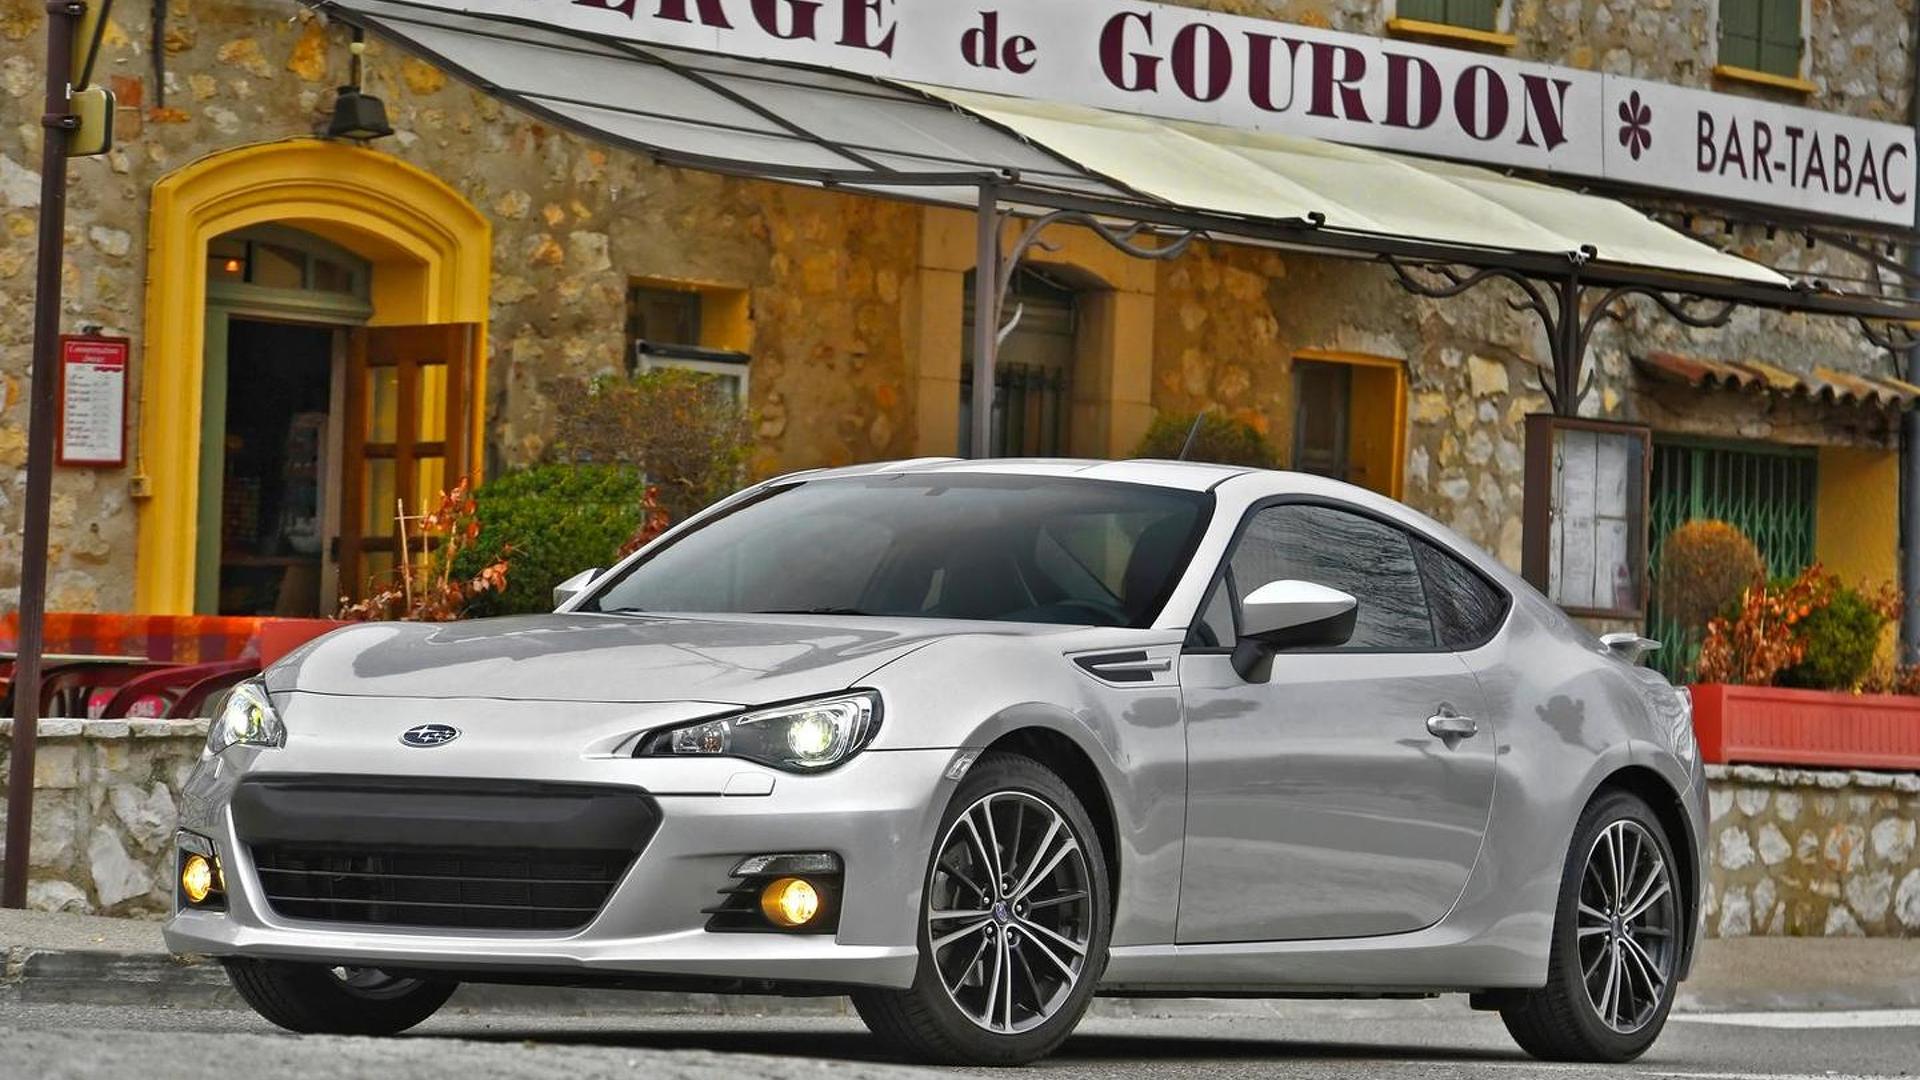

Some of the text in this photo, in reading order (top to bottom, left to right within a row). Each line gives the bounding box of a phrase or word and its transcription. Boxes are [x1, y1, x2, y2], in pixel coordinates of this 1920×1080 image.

[961, 13, 1037, 75] de
[1098, 11, 1572, 152] GOURDON
[1697, 110, 1908, 206] BAR-TABAC
